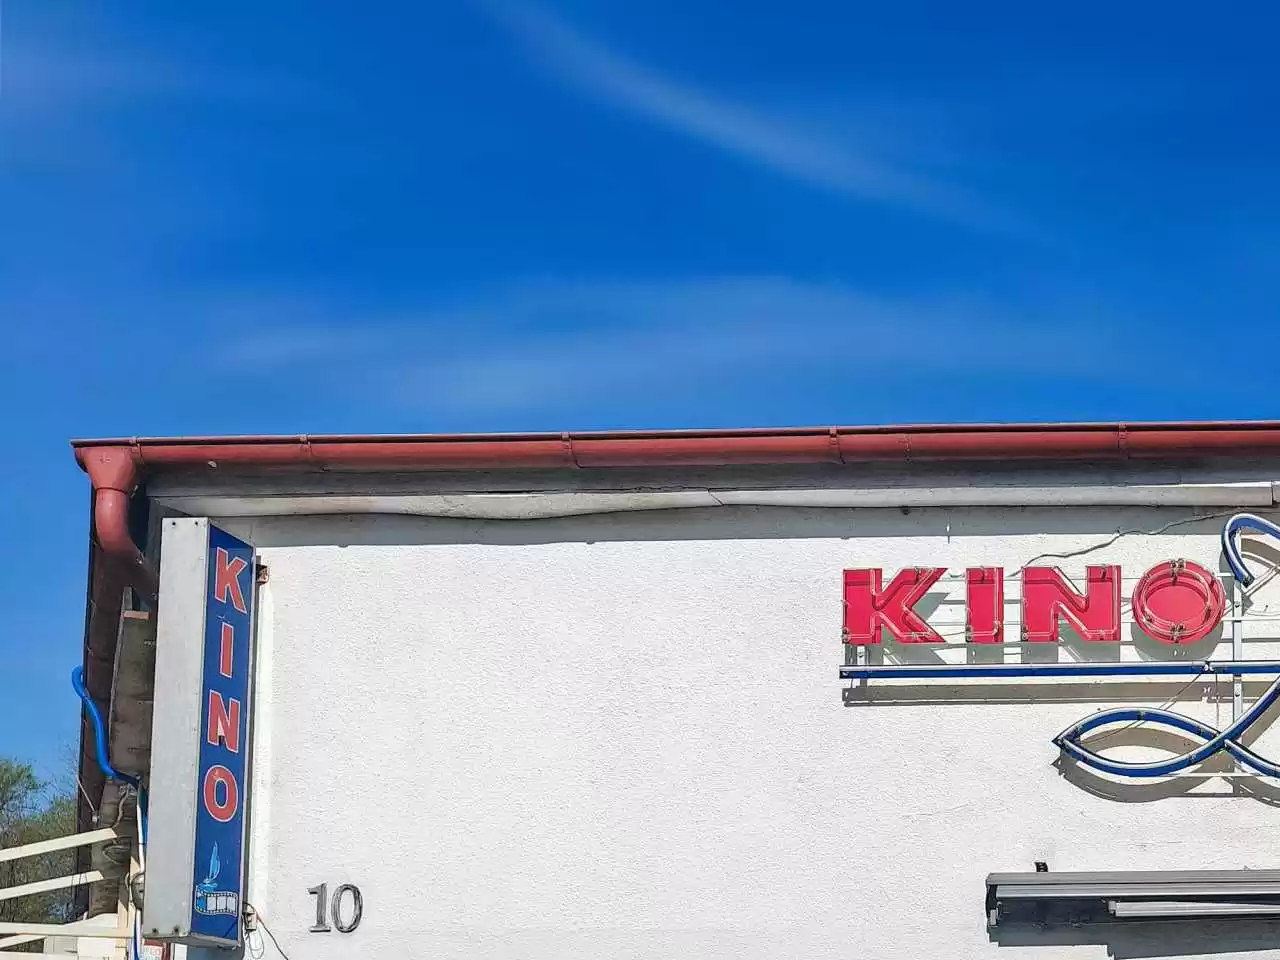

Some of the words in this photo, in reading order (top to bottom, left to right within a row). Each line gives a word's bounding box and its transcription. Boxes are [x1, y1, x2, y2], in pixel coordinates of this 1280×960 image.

[842, 558, 1227, 648] KINO
[203, 545, 248, 824] KINO
[308, 882, 364, 934] 10
